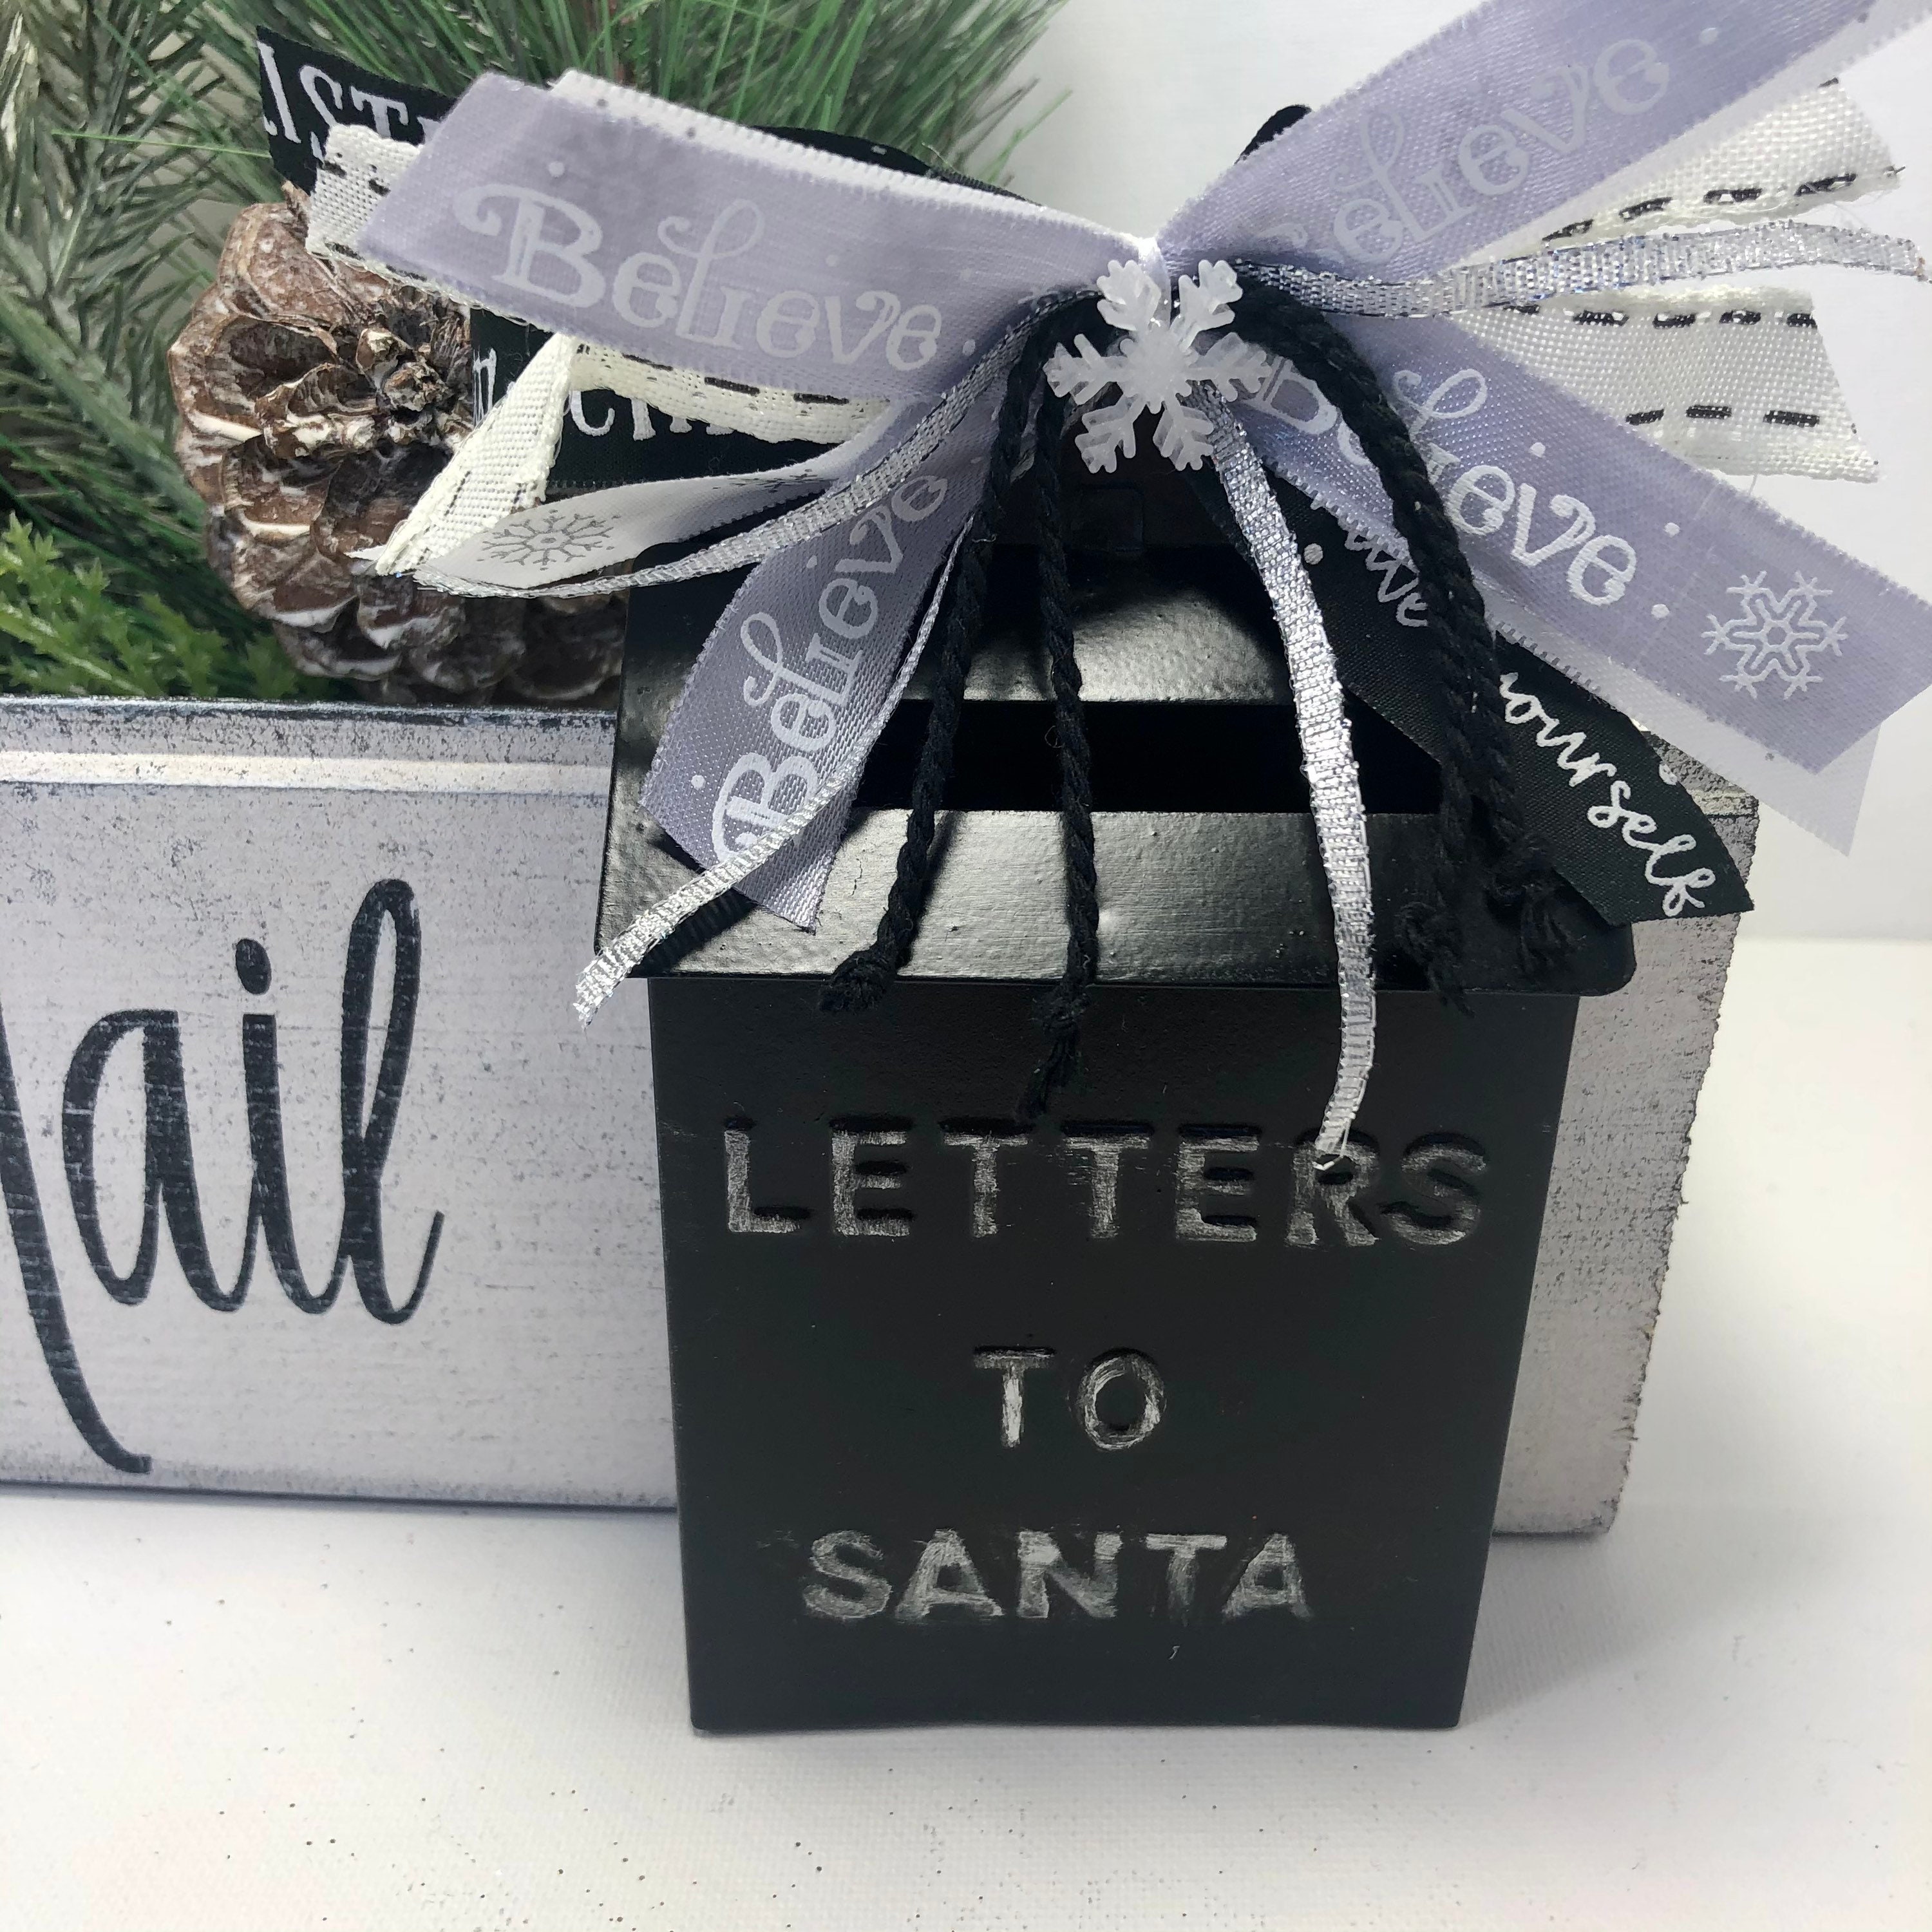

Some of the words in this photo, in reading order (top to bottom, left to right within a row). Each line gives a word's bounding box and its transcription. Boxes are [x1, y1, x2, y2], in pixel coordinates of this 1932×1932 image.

[1256, 39, 1670, 263] elieve
[453, 183, 942, 371] Believe
[710, 474, 948, 864] Believe
[1499, 672, 1715, 918] ourself
[0, 878, 444, 1474] ail
[723, 1117, 1488, 1247] LETTERS
[973, 1346, 1165, 1452] TO
[801, 1528, 1314, 1625] SANTA
